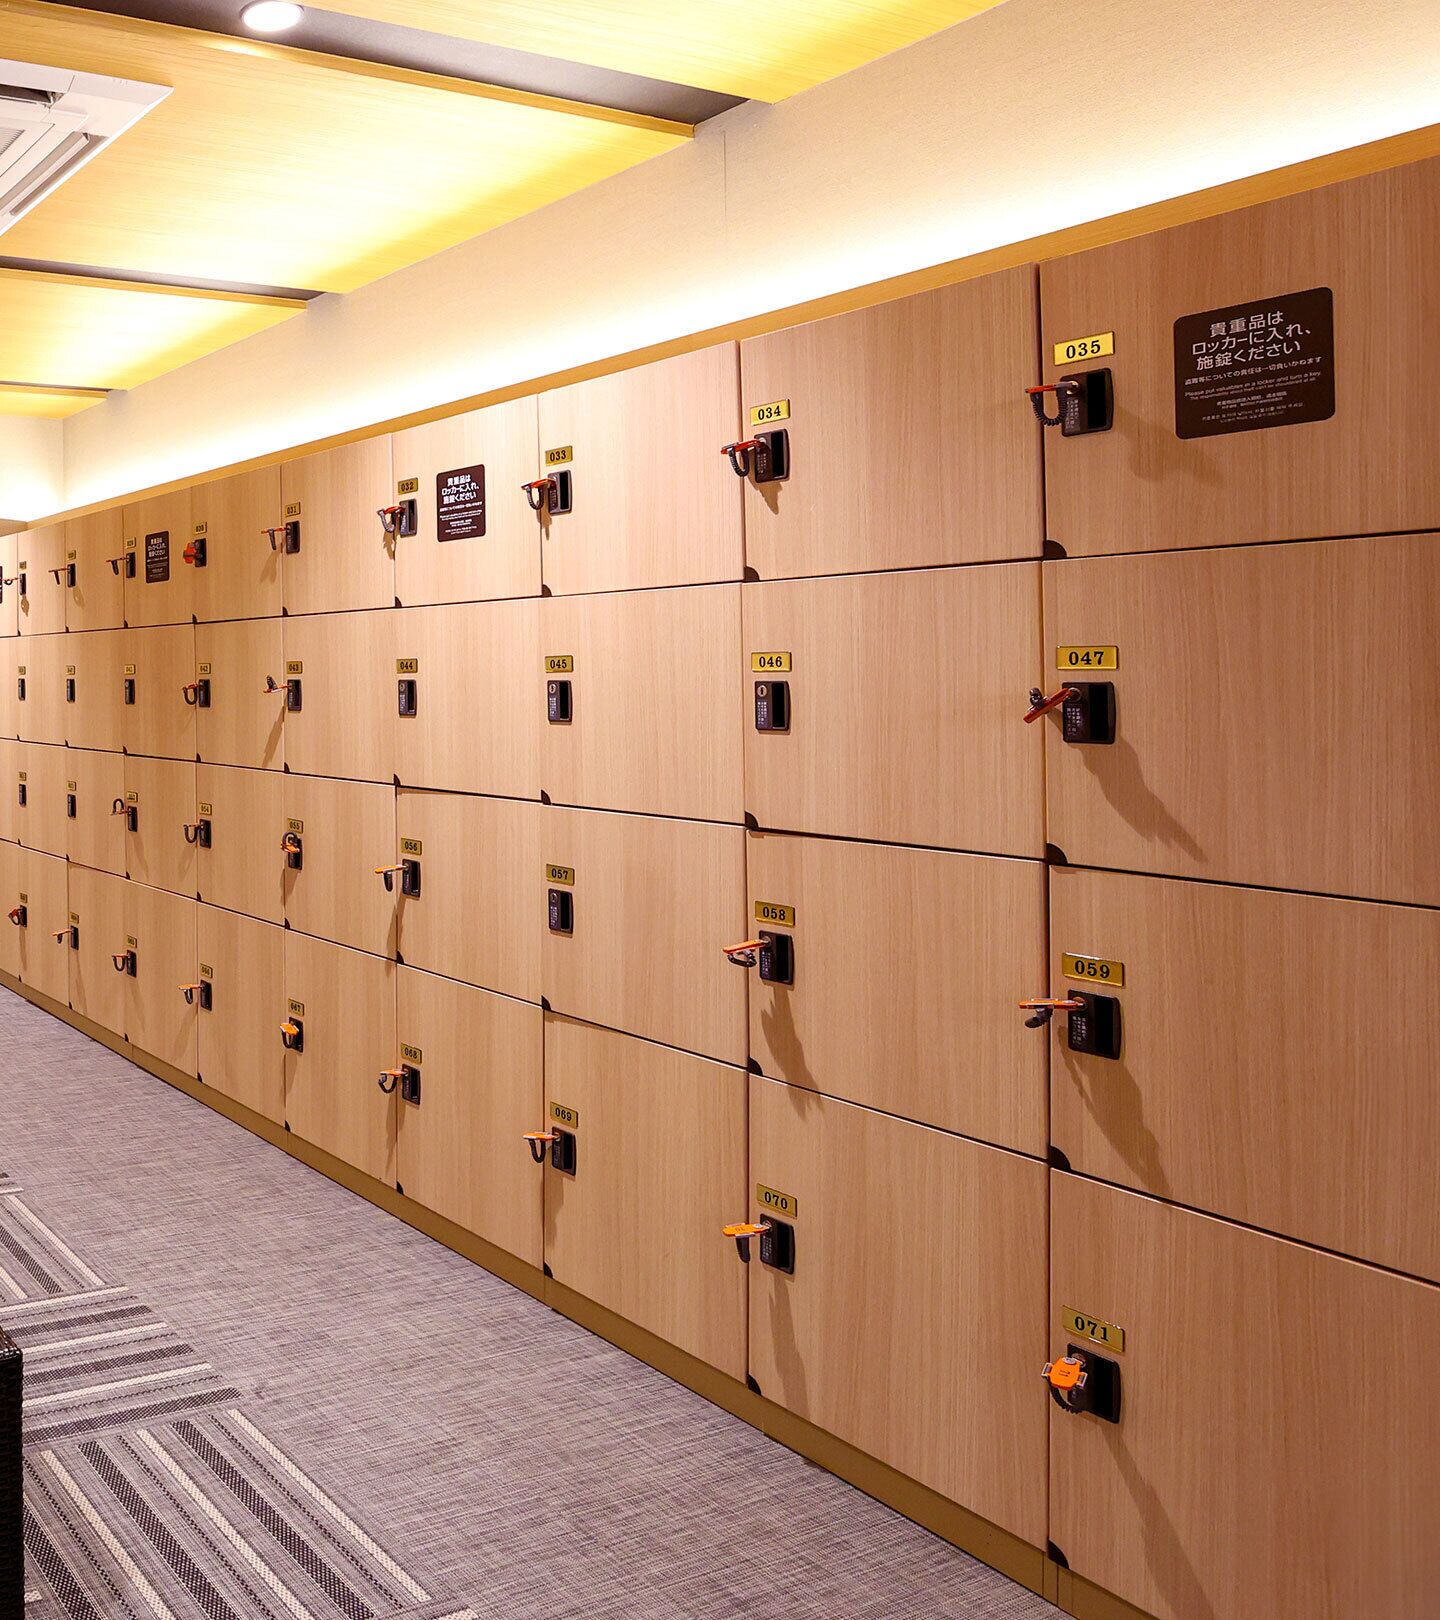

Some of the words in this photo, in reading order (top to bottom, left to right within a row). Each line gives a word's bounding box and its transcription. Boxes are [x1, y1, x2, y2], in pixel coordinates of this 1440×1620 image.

[1210, 311, 1284, 338] 貴重品は
[1192, 324, 1311, 355] ロッカーに入れ、
[1066, 340, 1101, 359] 035
[1196, 340, 1301, 371] 施錠ください
[758, 405, 781, 420] 034
[549, 450, 566, 462] 033
[400, 481, 414, 492] 032
[399, 661, 413, 671] 044
[549, 660, 566, 670] 045
[759, 656, 782, 668] 046
[1069, 651, 1104, 666] 047
[404, 842, 417, 852] 056
[551, 868, 568, 880] 057
[762, 906, 786, 921] 058
[1074, 960, 1110, 979] 059
[404, 1047, 418, 1059] 068
[554, 1107, 572, 1122] 069
[764, 1191, 788, 1209] 070
[1074, 1316, 1109, 1342] 071
